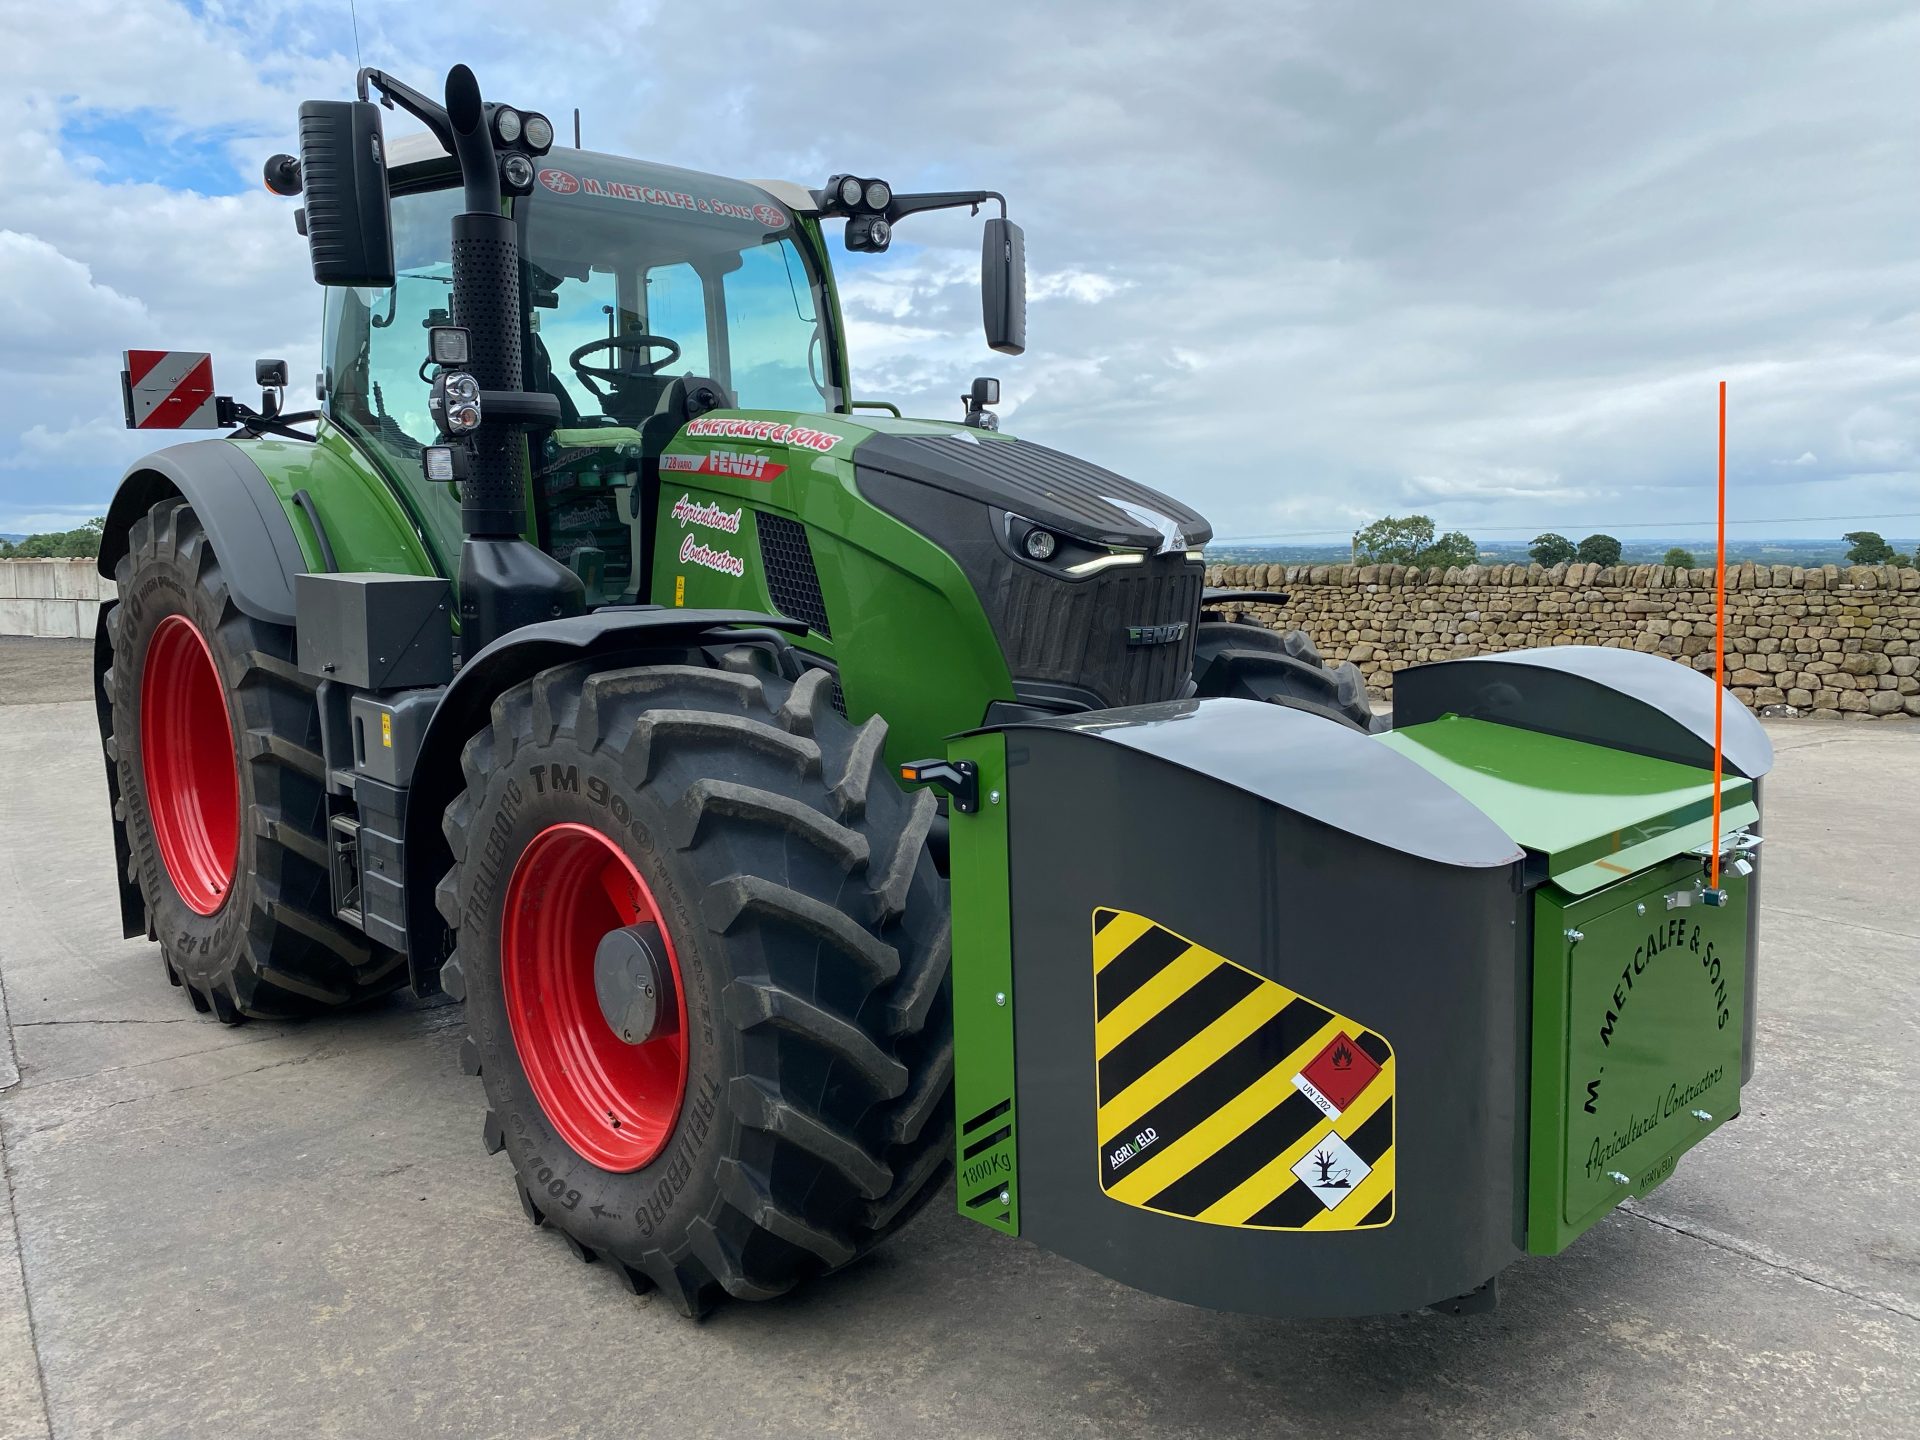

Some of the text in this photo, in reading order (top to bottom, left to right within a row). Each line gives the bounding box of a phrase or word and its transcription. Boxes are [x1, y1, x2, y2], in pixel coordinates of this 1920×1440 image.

[698, 198, 713, 214] &
[771, 424, 791, 443] &
[788, 428, 843, 452] SONS
[664, 456, 691, 469] 728 VARIO
[709, 450, 770, 477] FENDT
[671, 493, 742, 534] Agricultural
[679, 533, 744, 577] Contractors
[1128, 622, 1189, 643] FENDT
[463, 777, 523, 937] TRELLEBORG
[1600, 918, 1687, 1048] METCALFE
[1689, 925, 1700, 955] &
[1703, 941, 1729, 1031] SONS
[1302, 1083, 1331, 1112] UN 1202
[1585, 1065, 1723, 1182] Agricultural Contractors
[635, 1073, 722, 1238] TRELLEBORG
